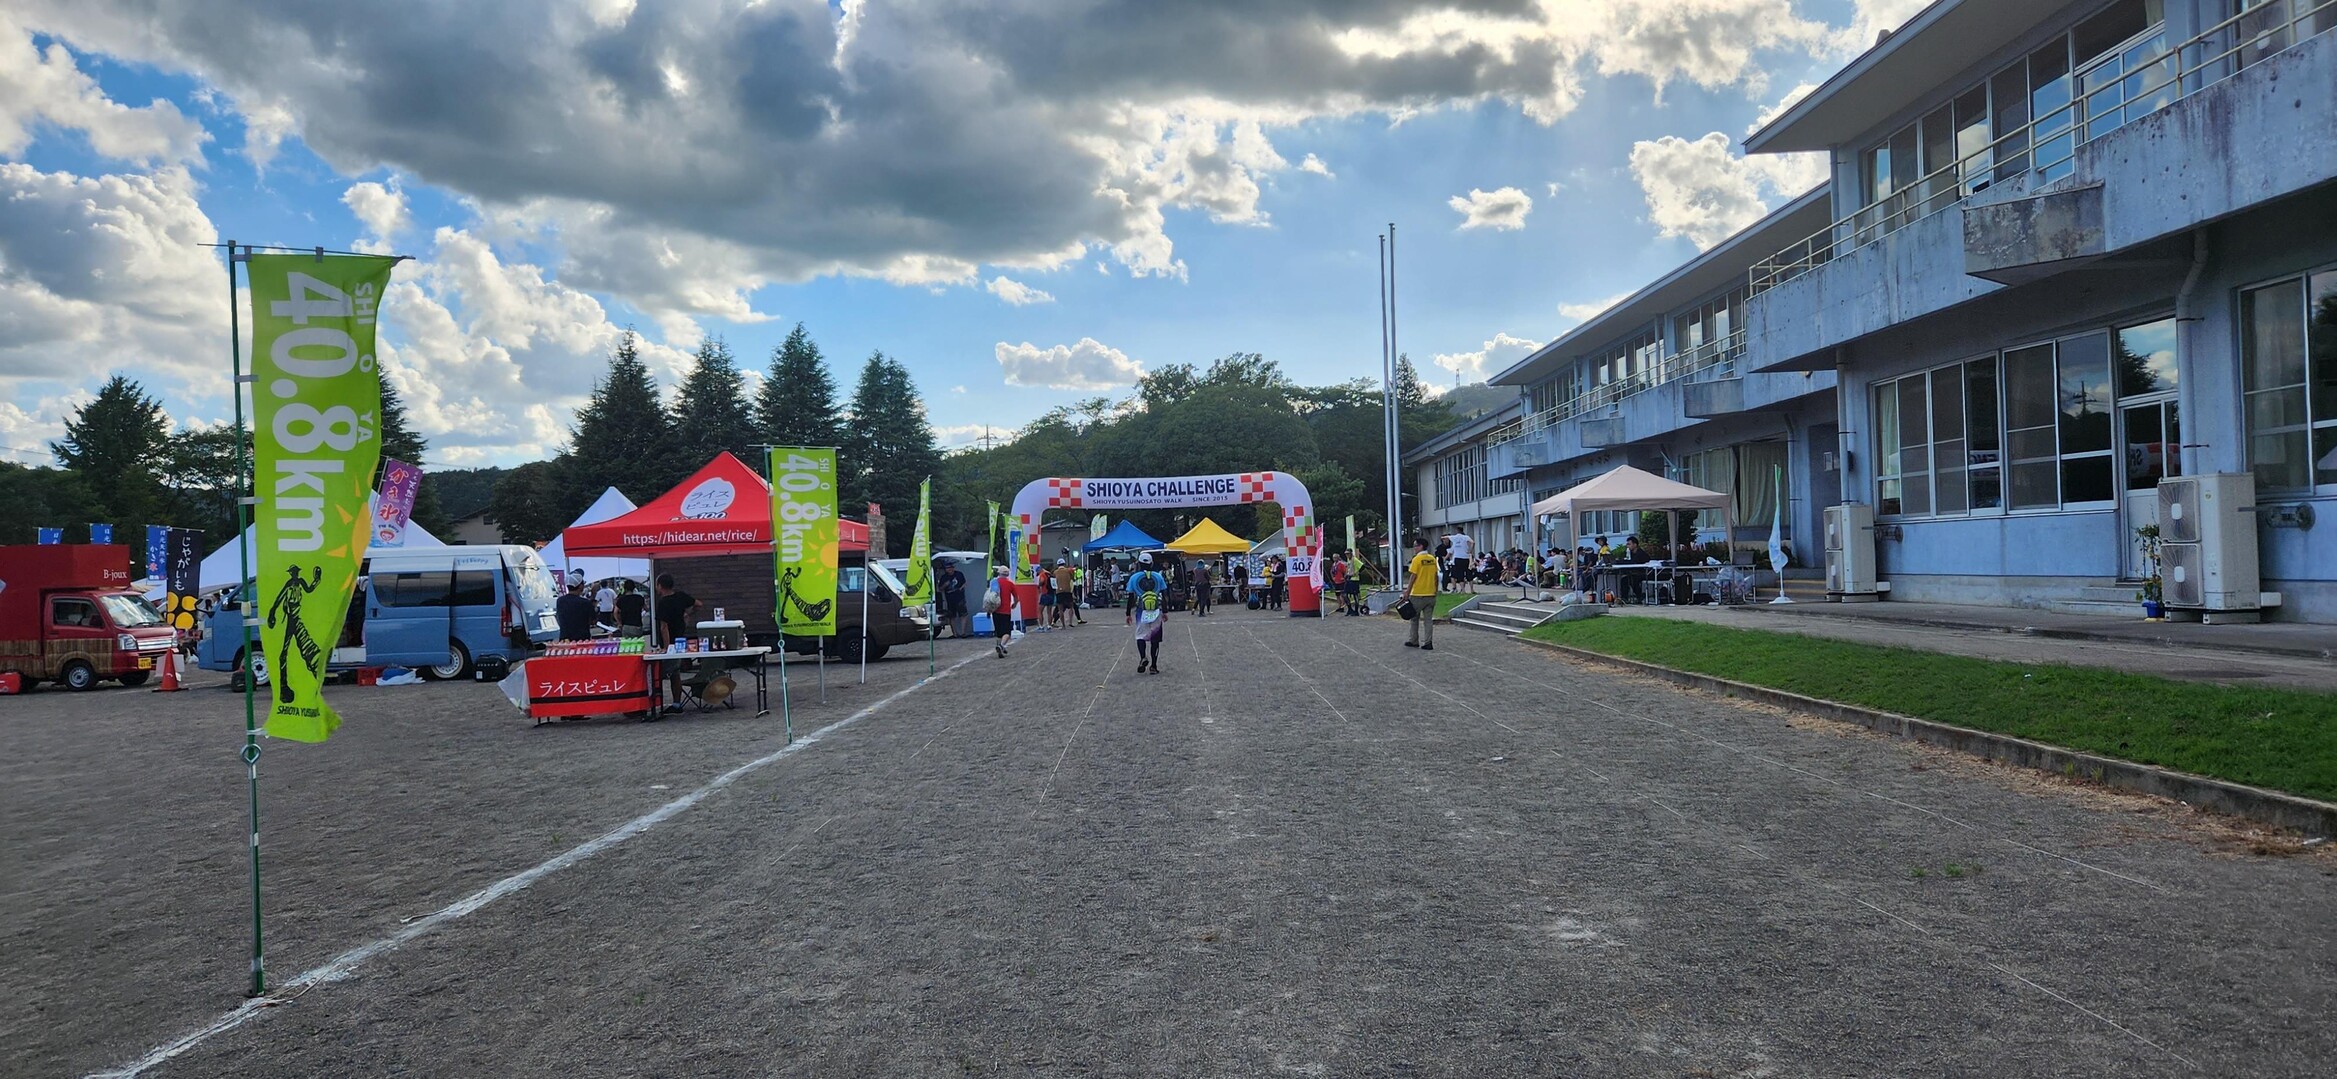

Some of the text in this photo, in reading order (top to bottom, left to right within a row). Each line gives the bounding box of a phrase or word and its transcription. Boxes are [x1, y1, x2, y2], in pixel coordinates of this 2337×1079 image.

[354, 282, 375, 444] SHI O YA
[270, 271, 359, 552] 40.8km
[819, 458, 830, 473] SHI
[691, 490, 730, 501] ライス
[1087, 478, 1235, 497] SHIOYA CHALLENGE
[779, 453, 822, 563] 40.8km
[821, 503, 831, 518] YA
[623, 529, 758, 547] https://hidear.net/rice/
[174, 536, 193, 591] じゃがいも
[103, 568, 128, 581] B-joux
[539, 679, 627, 698] ライスピュレ
